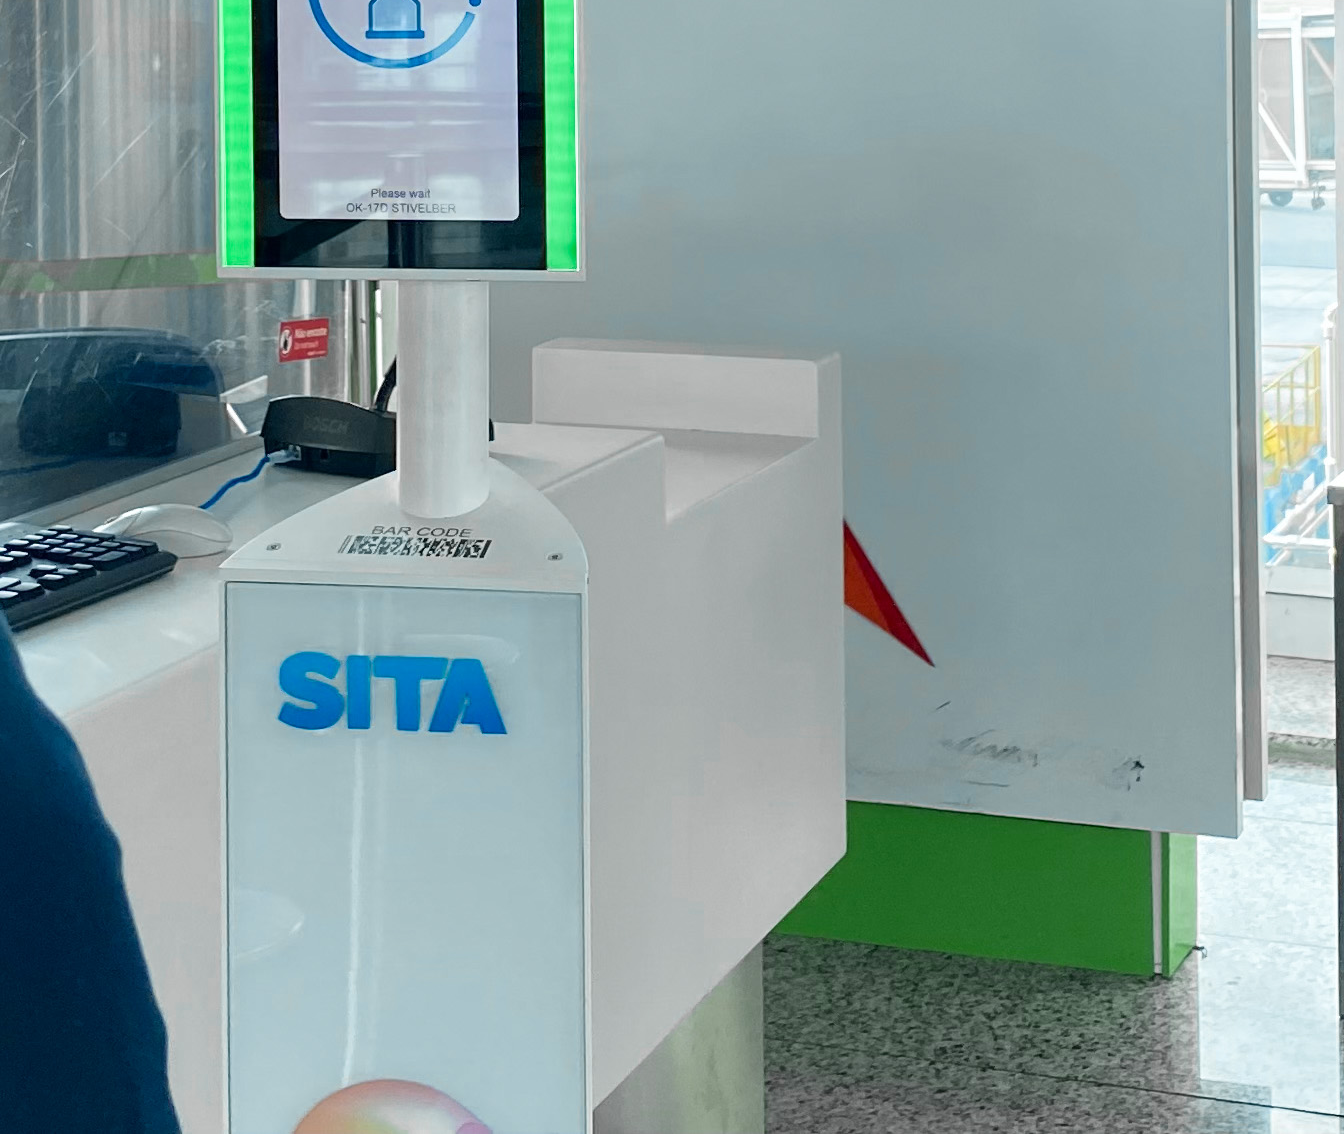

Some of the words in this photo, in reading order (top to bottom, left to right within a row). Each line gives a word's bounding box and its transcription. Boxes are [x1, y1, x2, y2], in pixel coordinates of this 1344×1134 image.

[370, 188, 407, 199] Please
[409, 188, 431, 199] wait
[346, 202, 388, 213] OK-17D
[371, 525, 413, 536] BAR
[416, 526, 472, 539] CODE
[277, 651, 508, 735] SITA
